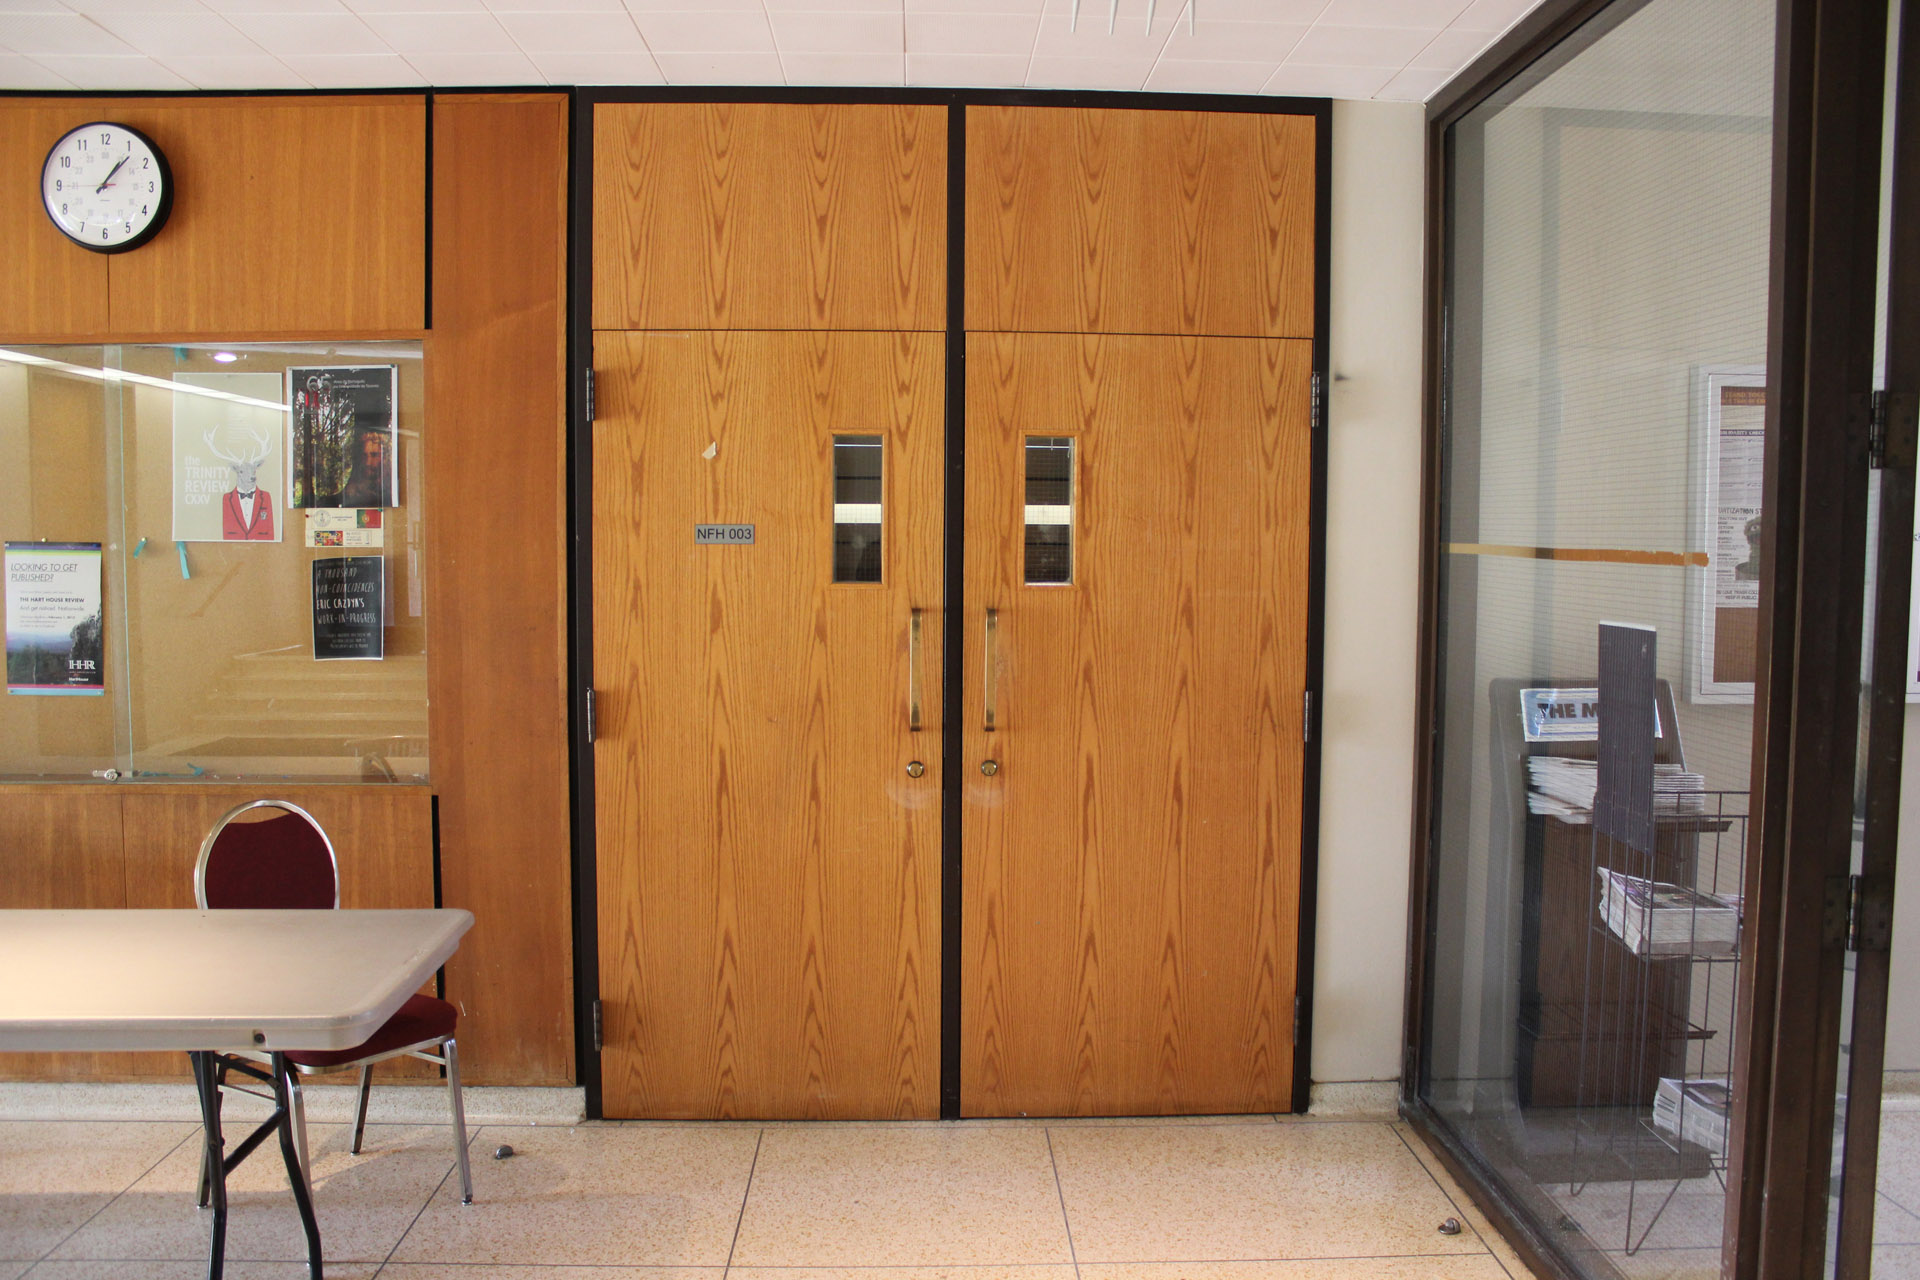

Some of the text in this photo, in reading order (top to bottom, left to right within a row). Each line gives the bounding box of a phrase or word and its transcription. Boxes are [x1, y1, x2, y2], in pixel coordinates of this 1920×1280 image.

[77, 139, 87, 151] 11
[101, 133, 111, 145] 12
[127, 140, 131, 152] 1
[60, 156, 71, 168] 10
[143, 157, 149, 169] 2
[56, 180, 62, 191] 9
[148, 181, 154, 193] 3
[62, 203, 68, 215] 8
[141, 204, 148, 216] 4
[80, 221, 85, 233] 7
[125, 222, 131, 234] 5
[102, 228, 108, 240] 6
[185, 466, 230, 479] TRINITY
[184, 480, 230, 493] REVIEW
[697, 528, 752, 539] NFH 003
[11, 563, 78, 572] LOOKING TO GET
[11, 573, 55, 582] PUBLISHED?
[316, 598, 331, 610] ERIC
[317, 612, 376, 624] WORK-IN-PROGRESS
[69, 659, 96, 670] HHR
[1537, 702, 1577, 719] THE
